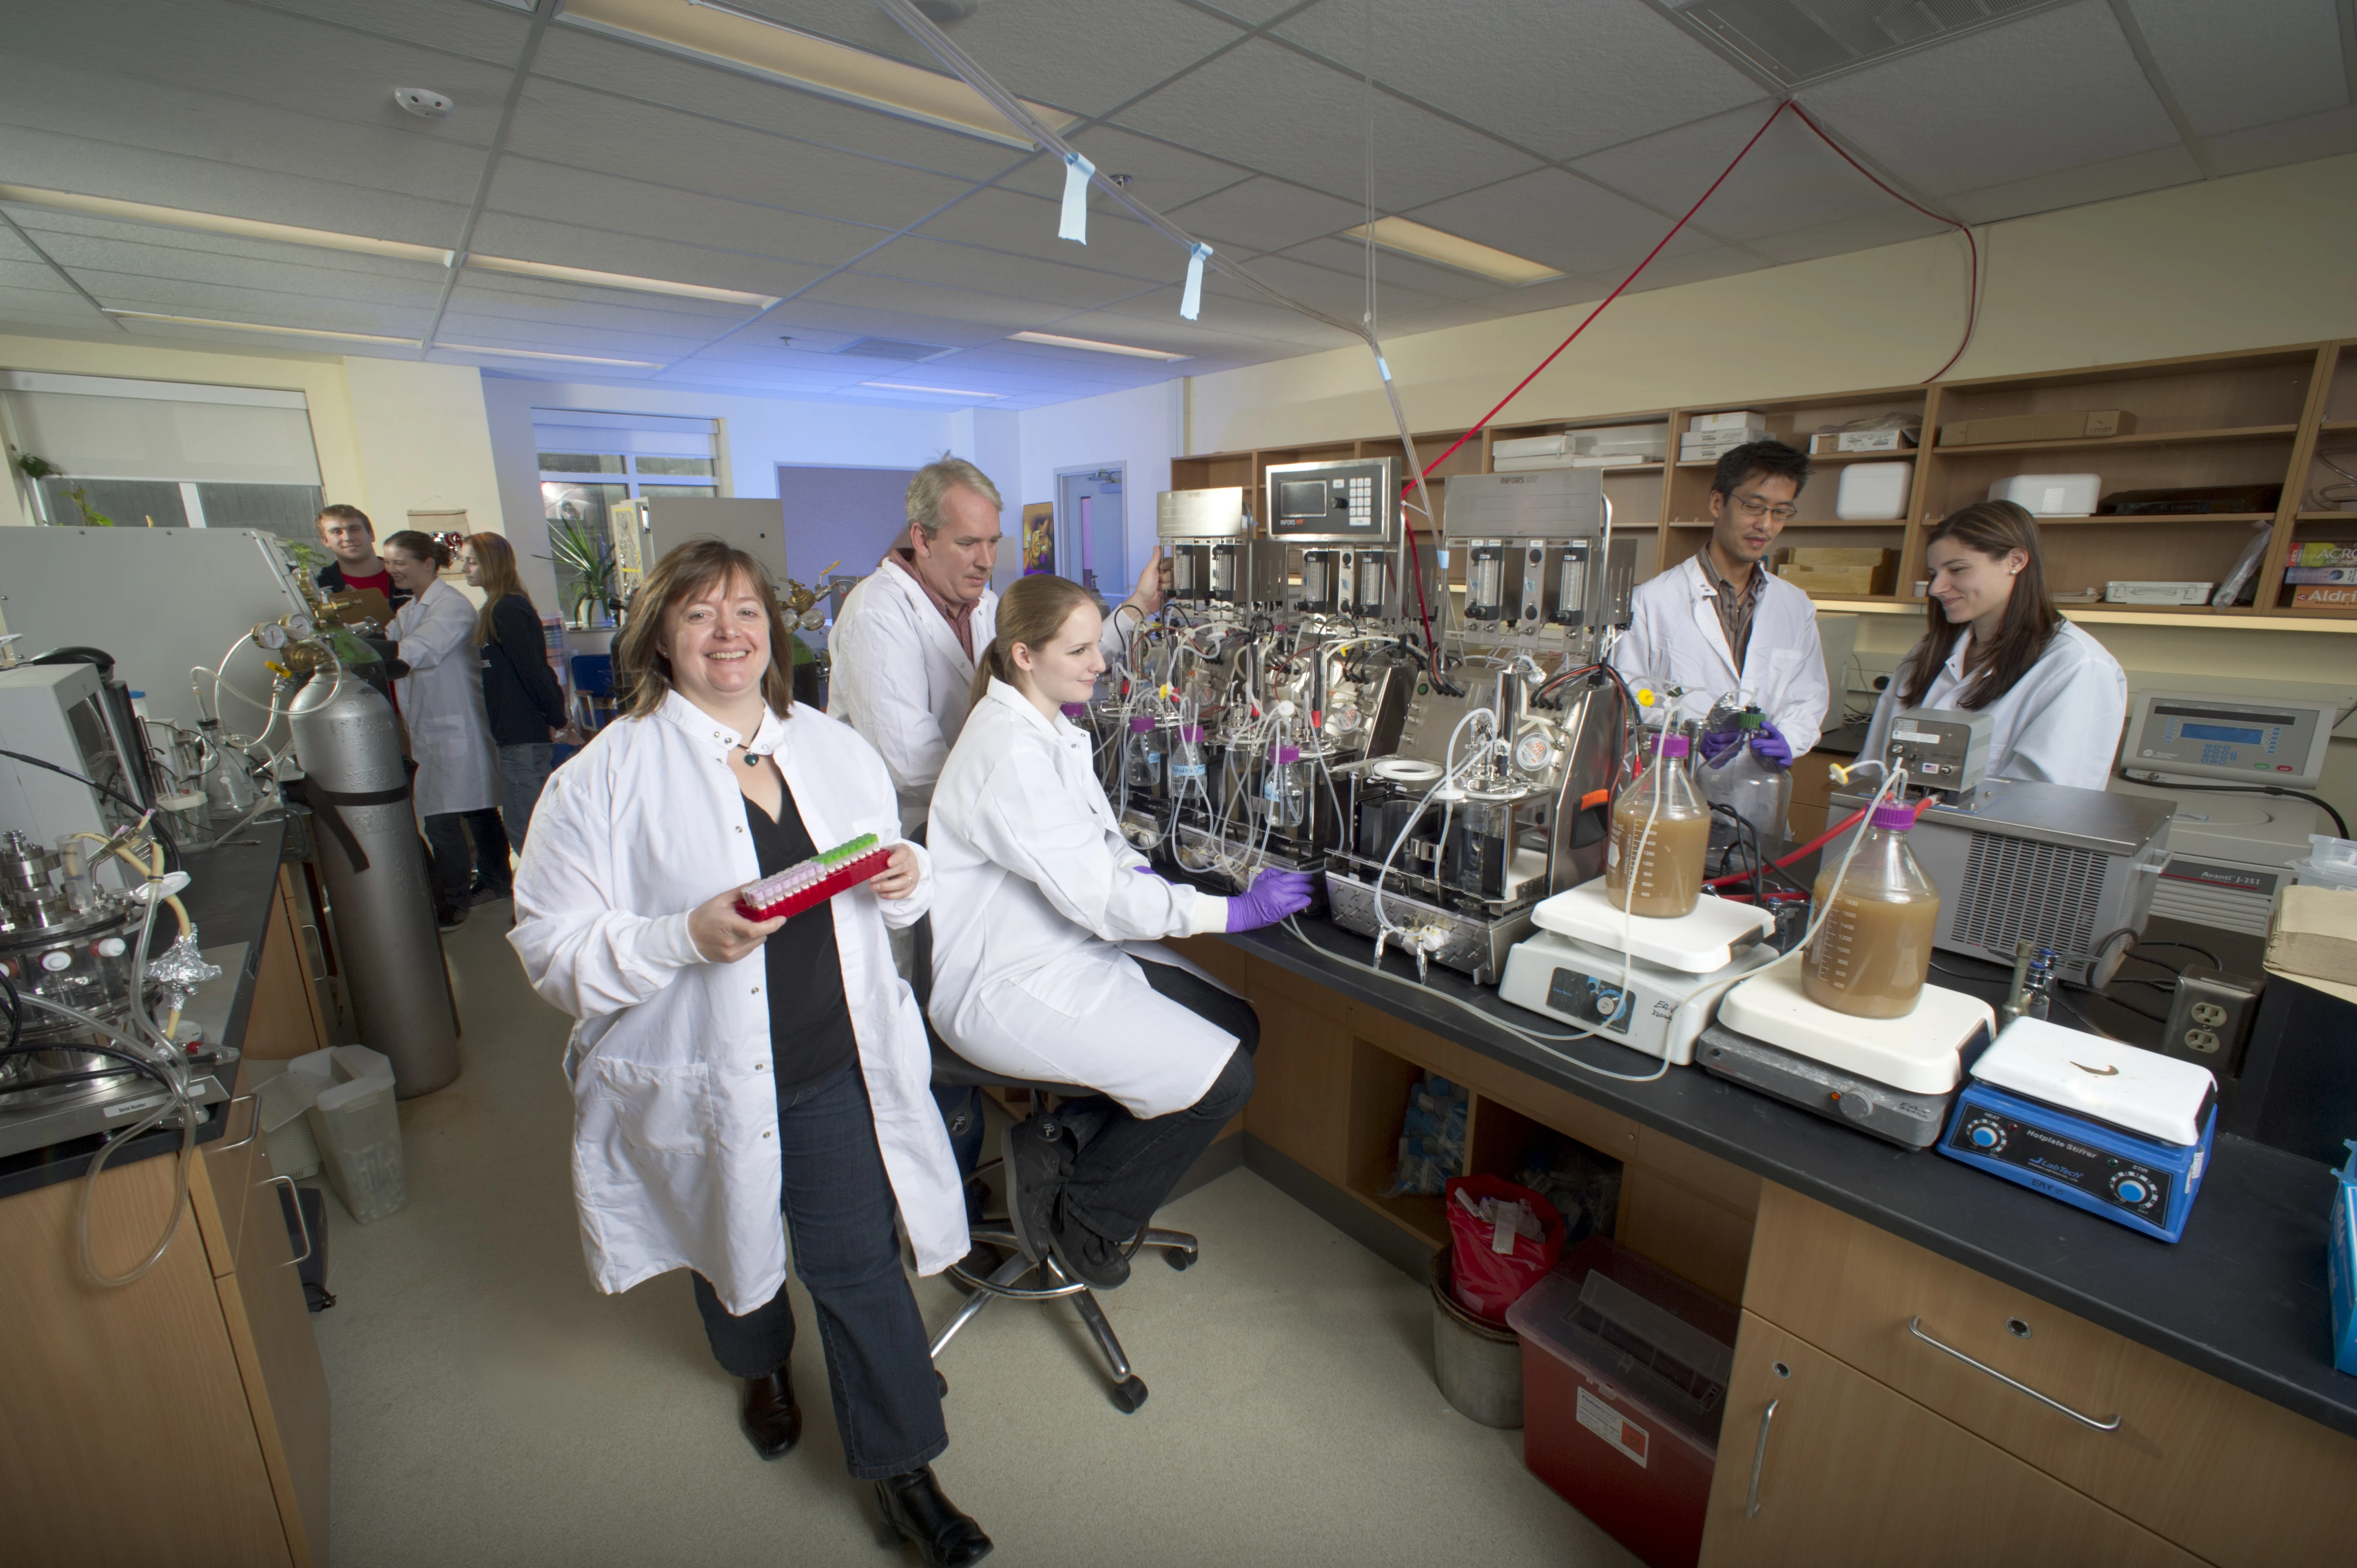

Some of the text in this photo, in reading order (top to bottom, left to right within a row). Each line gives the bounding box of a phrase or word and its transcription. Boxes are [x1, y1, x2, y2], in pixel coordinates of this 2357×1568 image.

[1500, 476, 1524, 484] INFORS
[1529, 742, 1542, 760] YEARS
[1535, 742, 1546, 752] 40
[2201, 871, 2231, 881] Avanti
[2026, 1129, 2098, 1158] Hotplate Stirrer
[2132, 1164, 2149, 1174] STIR
